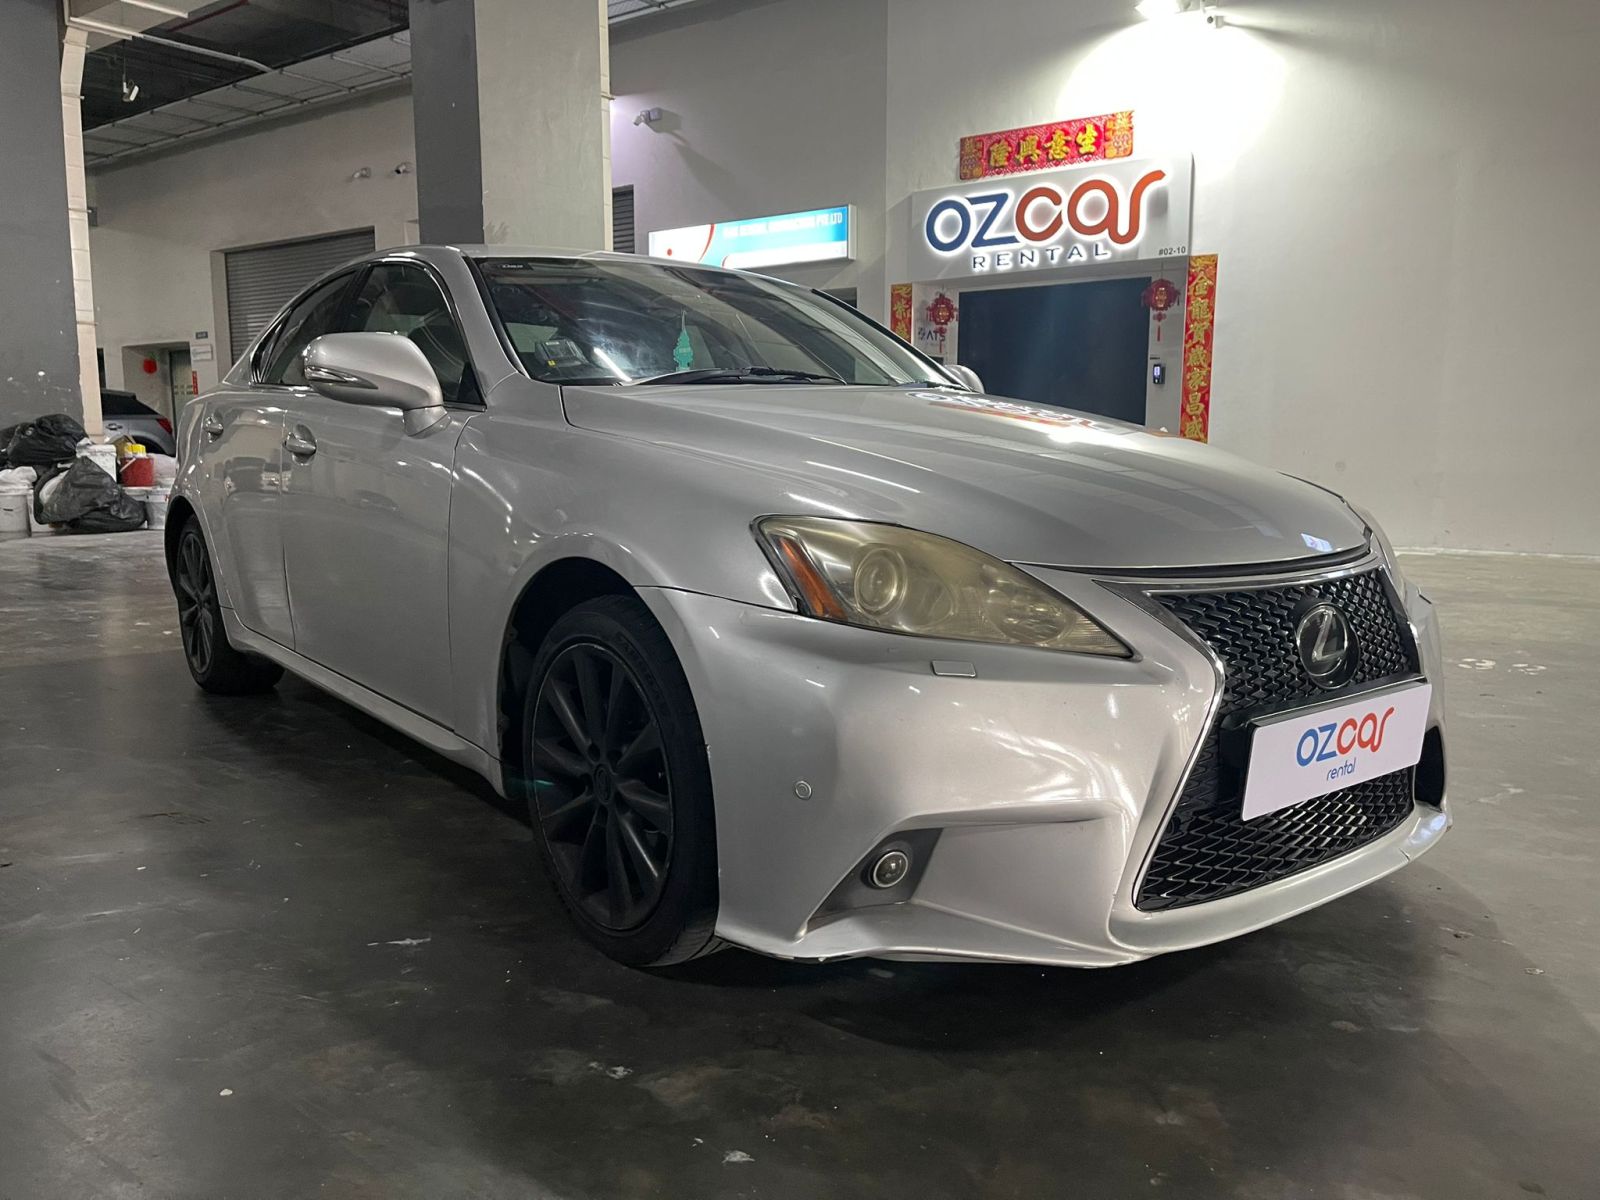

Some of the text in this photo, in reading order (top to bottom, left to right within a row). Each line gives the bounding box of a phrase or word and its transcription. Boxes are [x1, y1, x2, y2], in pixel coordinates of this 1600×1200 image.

[972, 243, 1109, 269] RENTAL
[1158, 246, 1186, 256] #02-10
[1326, 757, 1357, 781] rental
